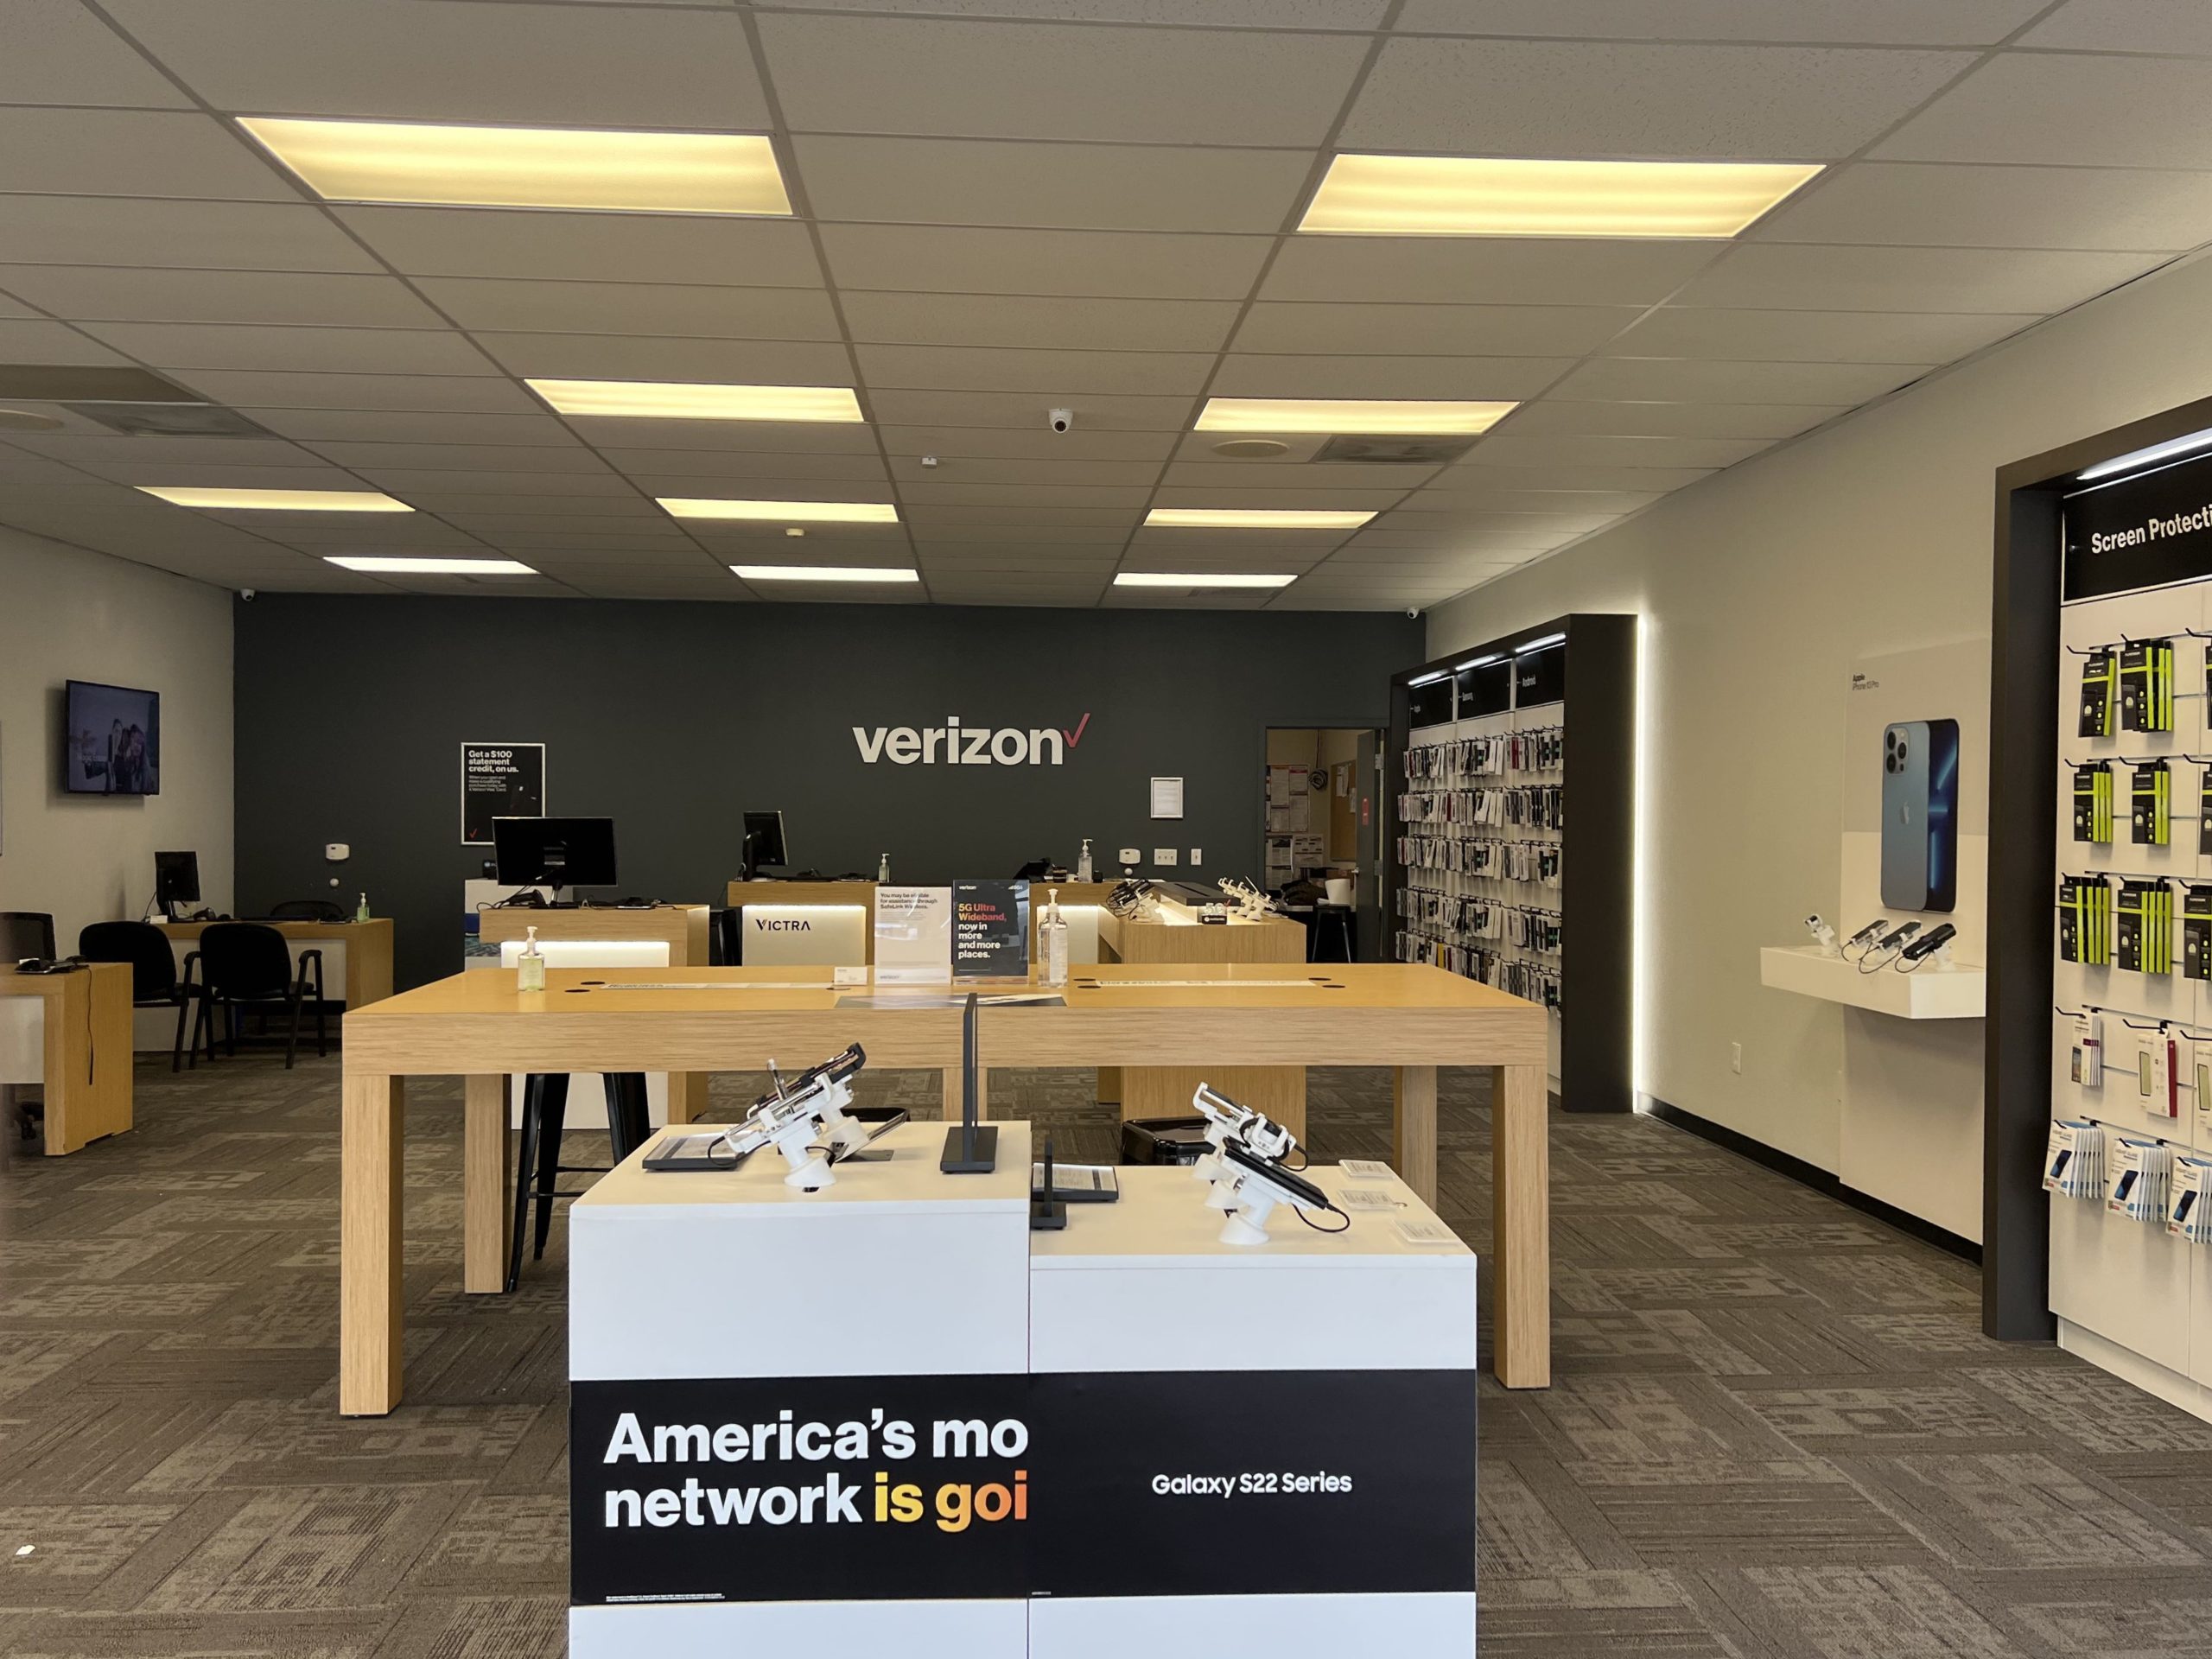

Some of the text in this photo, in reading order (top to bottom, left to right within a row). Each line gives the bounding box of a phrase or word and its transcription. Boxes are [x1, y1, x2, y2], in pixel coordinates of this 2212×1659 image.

[2091, 526, 2146, 554] Screen
[852, 715, 1064, 766] verizon
[958, 903, 996, 912] 5G Ultra
[958, 912, 1007, 922] Wideband,
[755, 918, 810, 931] VICTRA
[978, 921, 988, 931] in
[957, 940, 976, 950] and
[957, 950, 991, 960] places.
[932, 1418, 1029, 1459] mo
[1152, 1471, 1353, 1498] Galaxy S22 Series
[605, 1469, 1028, 1534] network is goi
